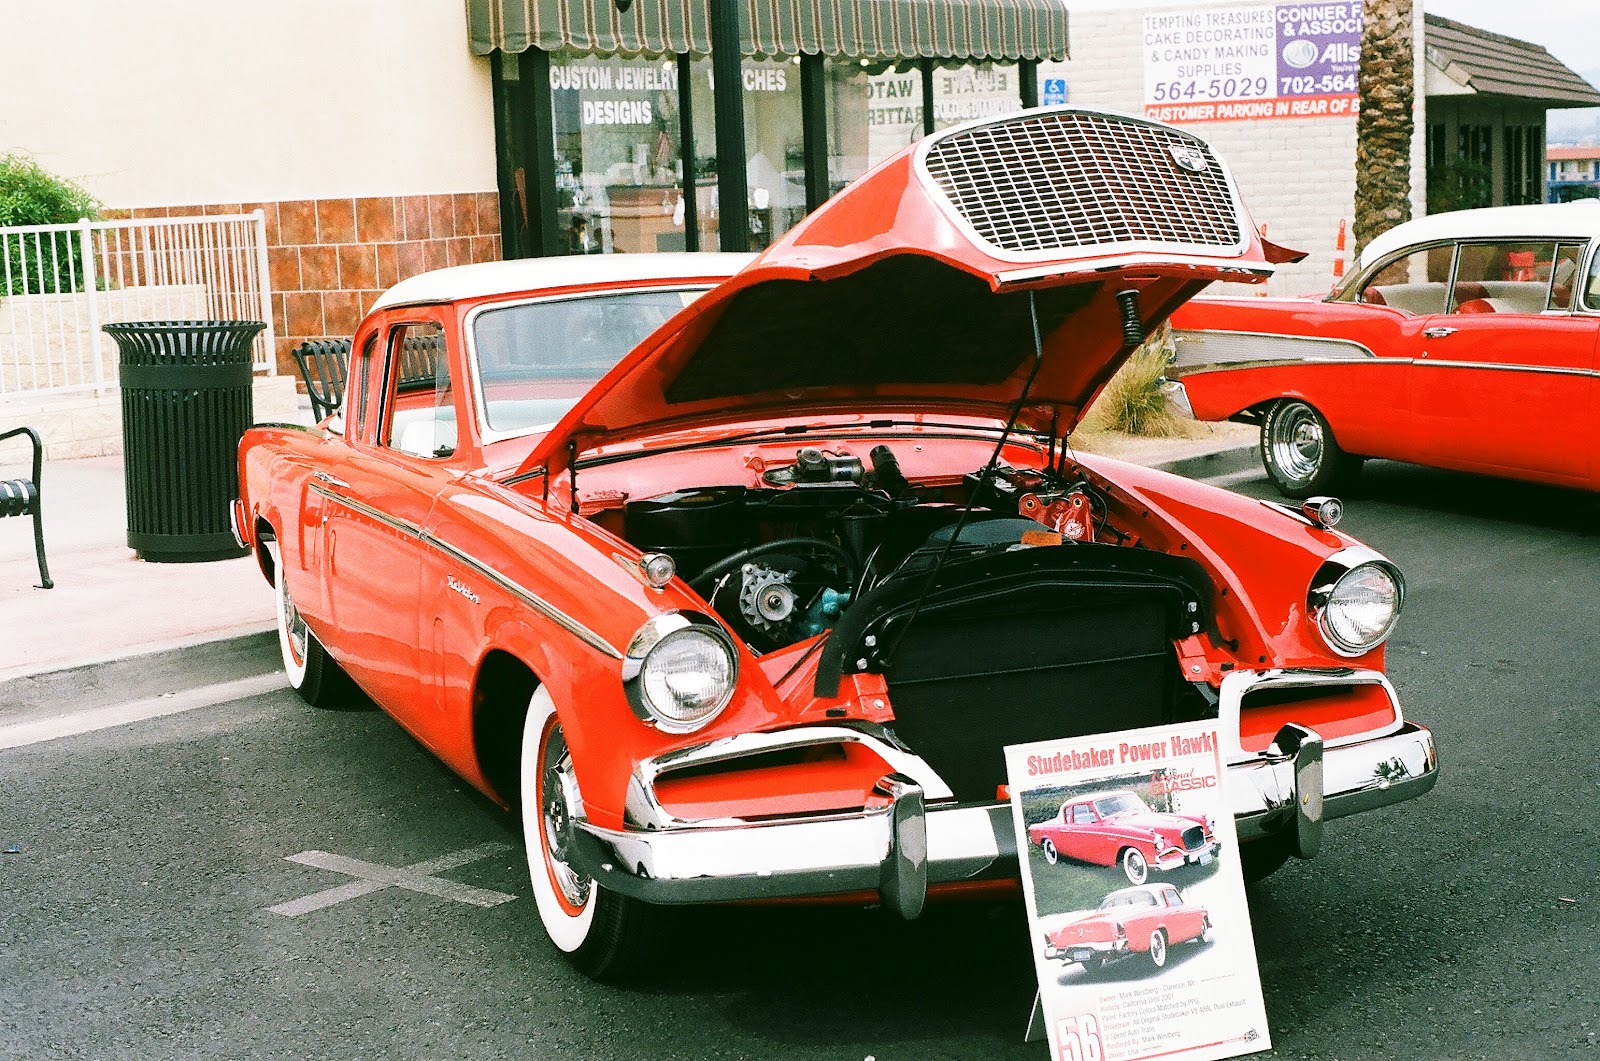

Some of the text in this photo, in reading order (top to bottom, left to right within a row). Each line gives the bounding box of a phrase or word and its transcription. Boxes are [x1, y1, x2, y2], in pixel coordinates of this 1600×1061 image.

[1146, 10, 1273, 30] TEMPTING TREASURES
[1277, 4, 1363, 23] CONNER F
[1145, 27, 1274, 46] CAKE DECORATING
[1283, 22, 1296, 37] &
[1152, 44, 1268, 62] & CANDY MAKING
[1319, 43, 1362, 63] Alls
[550, 66, 679, 91] CUSTOM JEWELRY
[1178, 63, 1242, 78] SUPPLIES
[1154, 77, 1267, 101] 564-5029
[1280, 74, 1359, 95] 702-564
[583, 101, 652, 125] DESIGNS
[1146, 103, 1215, 122] CUSTOMER
[1217, 100, 1274, 119] PARKING
[1275, 101, 1289, 116] IN
[1291, 99, 1328, 115] REAR
[1329, 98, 1349, 113] OF
[1027, 746, 1115, 776] Studebaker
[1119, 740, 1166, 764] Power
[1149, 775, 1217, 796] CLASSIC
[1161, 1010, 1190, 1020] Studebaker
[1057, 1013, 1102, 1061] 56
